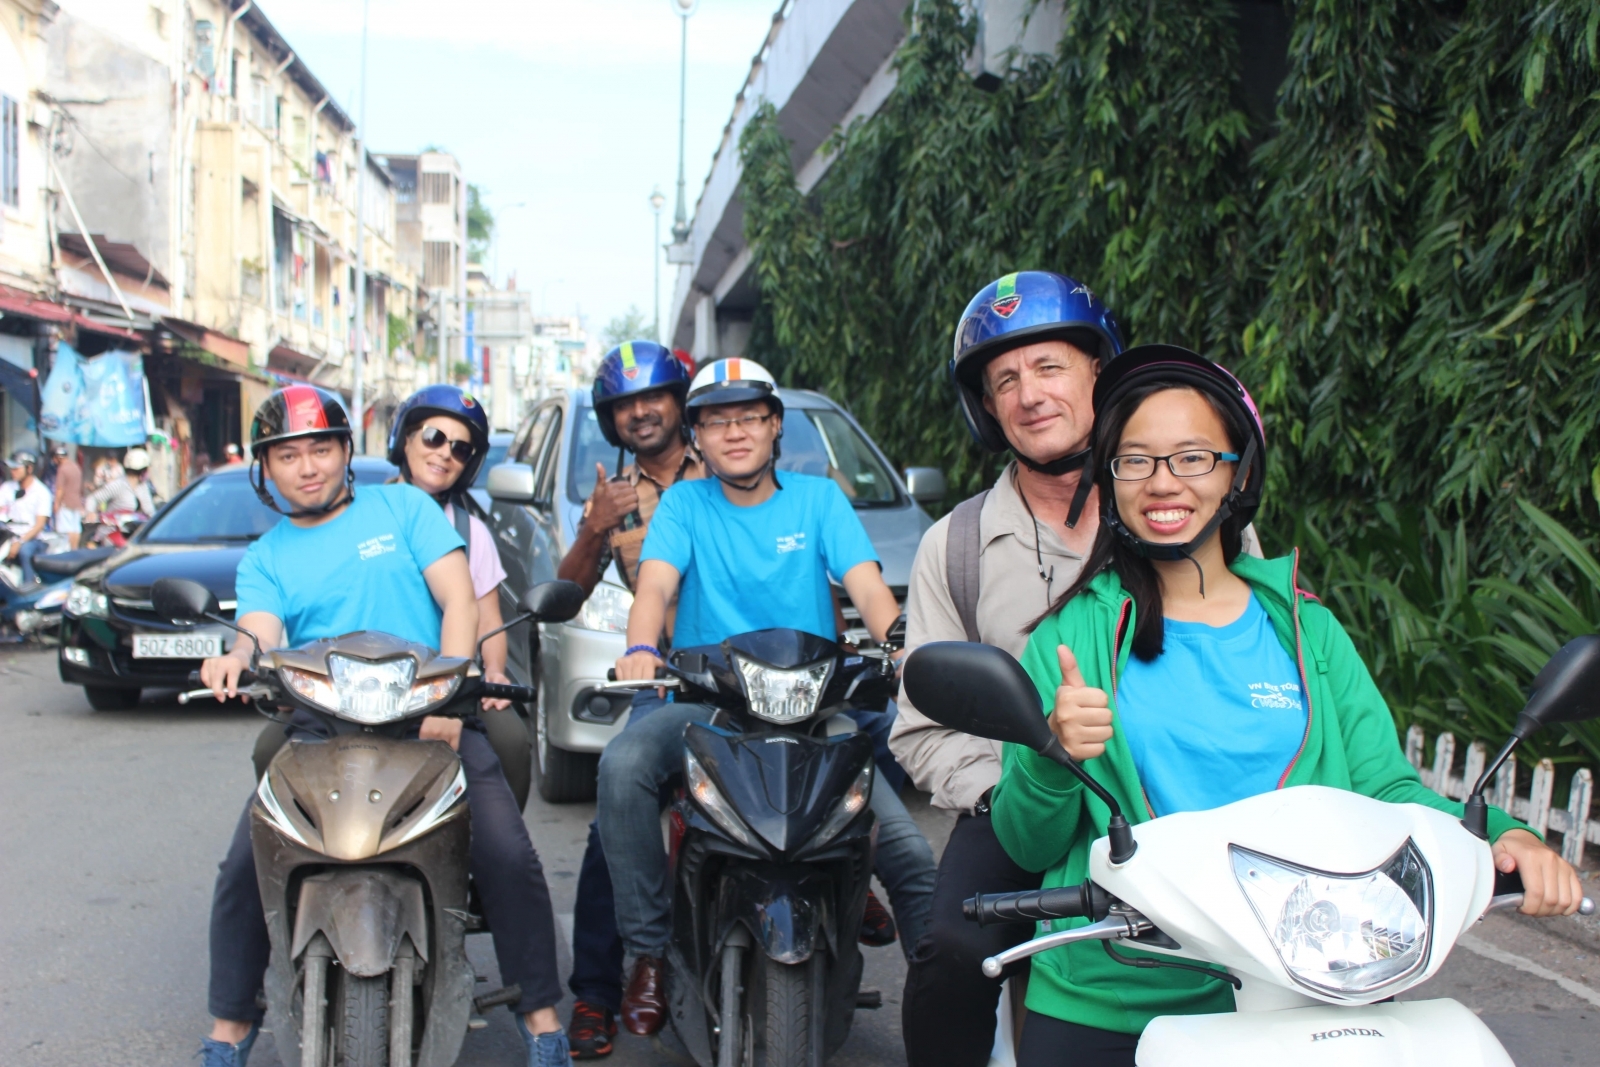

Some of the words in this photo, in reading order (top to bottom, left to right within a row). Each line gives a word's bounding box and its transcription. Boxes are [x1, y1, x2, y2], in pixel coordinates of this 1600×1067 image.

[1247, 682, 1262, 690] VN
[1263, 682, 1280, 692] BIKE
[1280, 682, 1300, 692] TOUR
[765, 737, 799, 745] HONDA
[1311, 1028, 1385, 1042] HONDA
